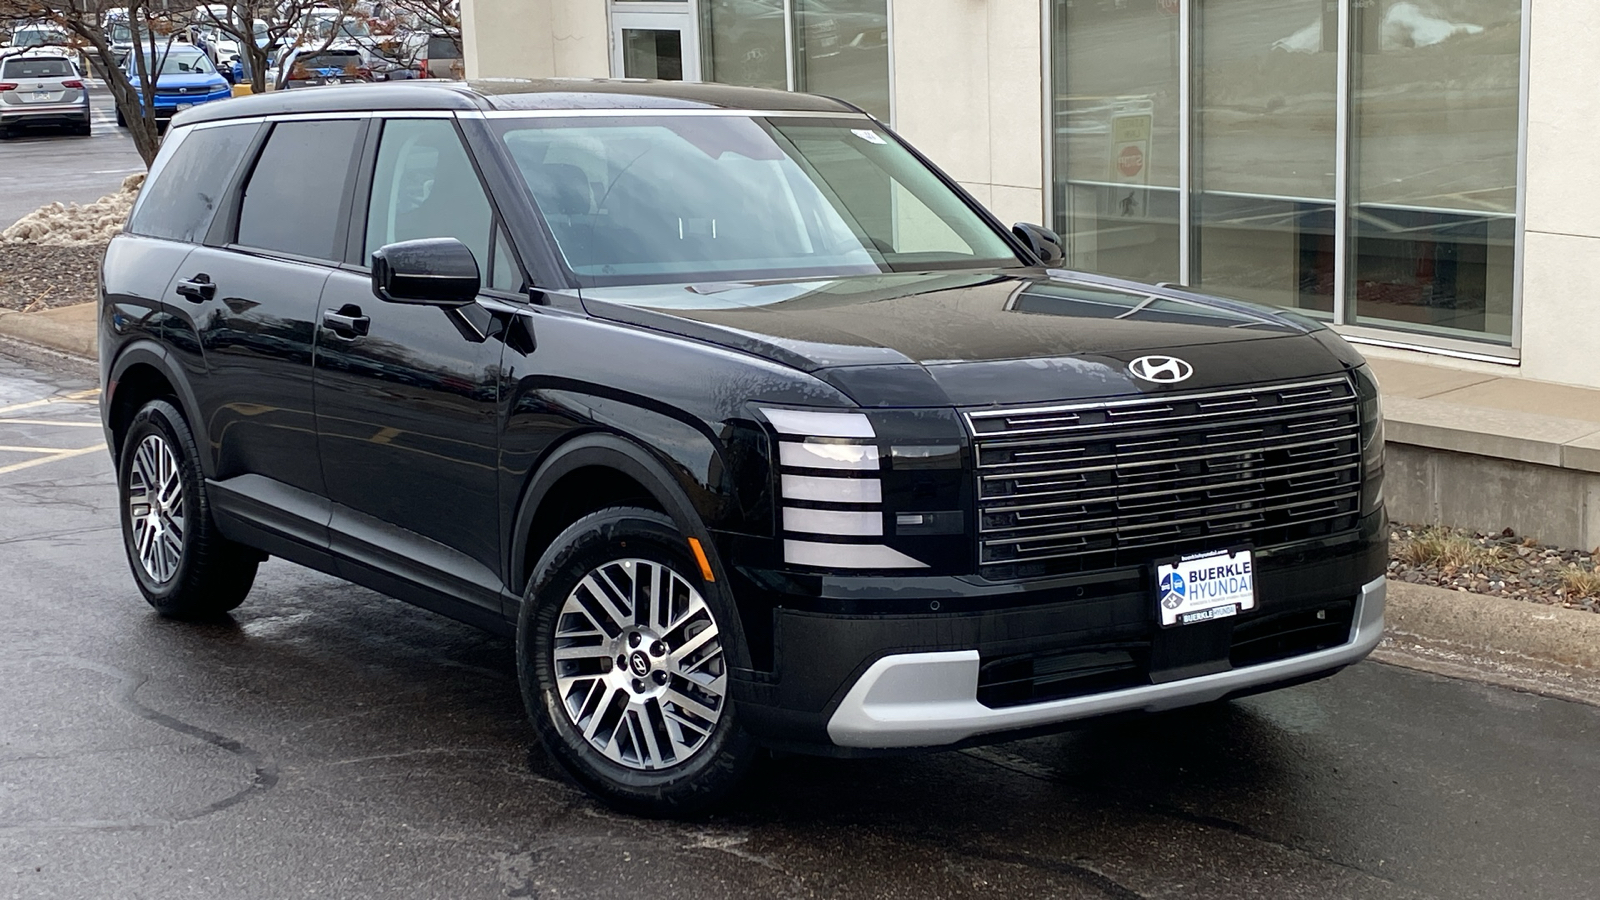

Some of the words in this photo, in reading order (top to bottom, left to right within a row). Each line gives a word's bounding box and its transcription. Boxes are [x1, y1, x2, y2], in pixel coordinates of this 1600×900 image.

[1189, 562, 1251, 583] BUERKLE
[1189, 575, 1252, 601] HYUNDAI
[1183, 610, 1213, 623] BUERKLE
[1213, 606, 1235, 617] HYUNDAI
